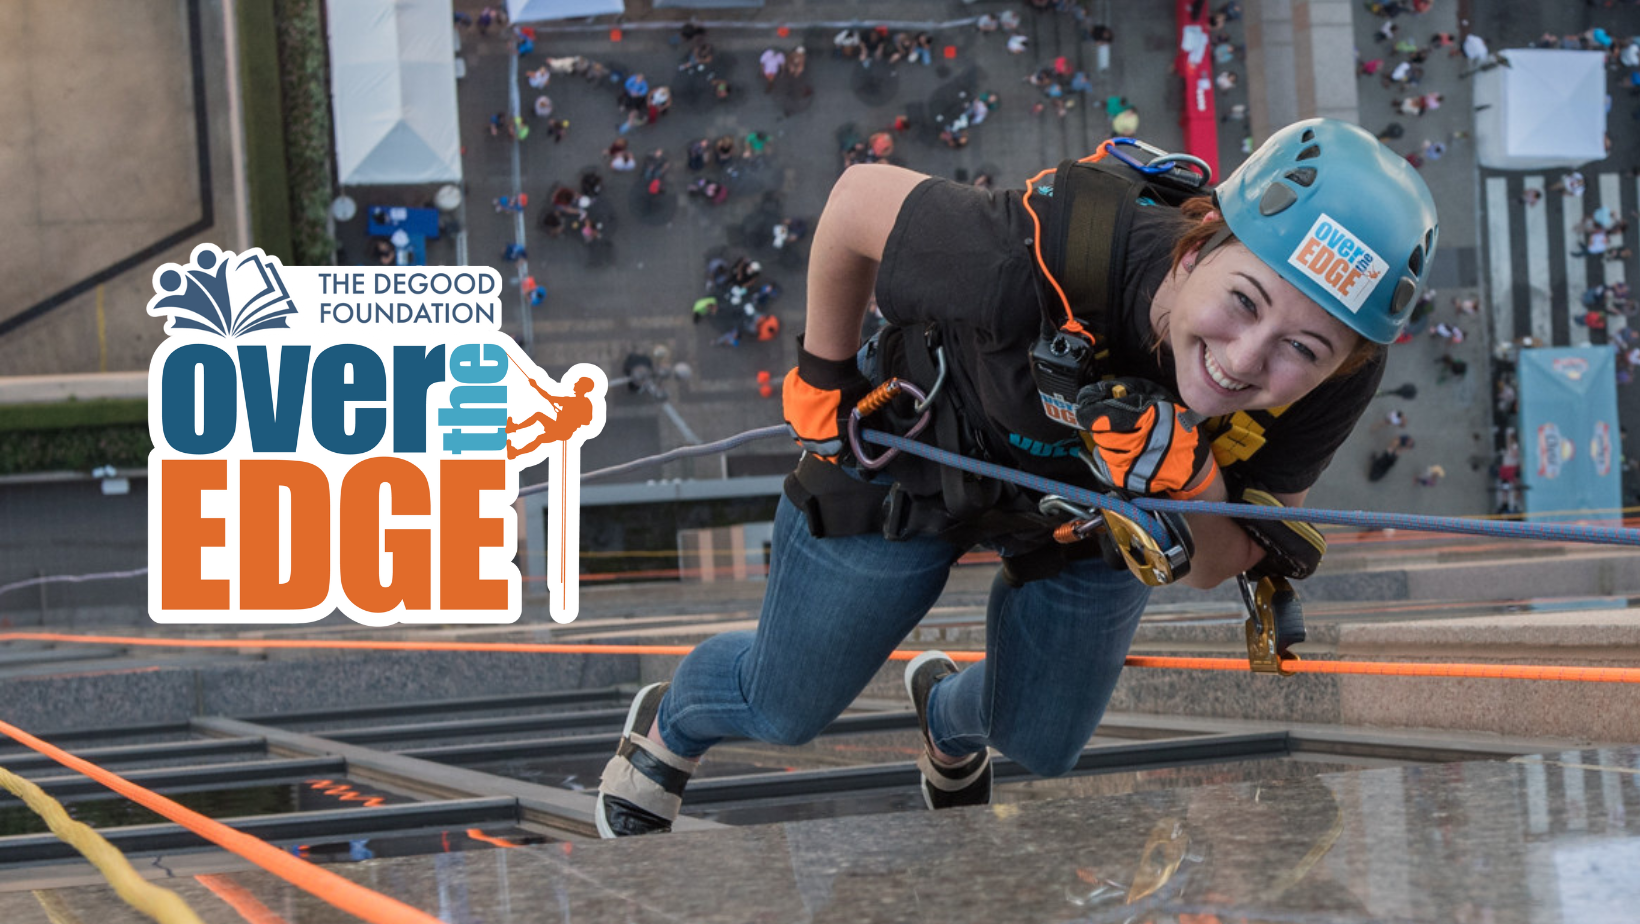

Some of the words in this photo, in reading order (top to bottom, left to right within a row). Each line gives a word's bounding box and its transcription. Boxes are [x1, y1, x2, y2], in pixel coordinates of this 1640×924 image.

[1315, 221, 1365, 264] over
[1355, 253, 1374, 272] the
[1296, 237, 1362, 297] EDGE
